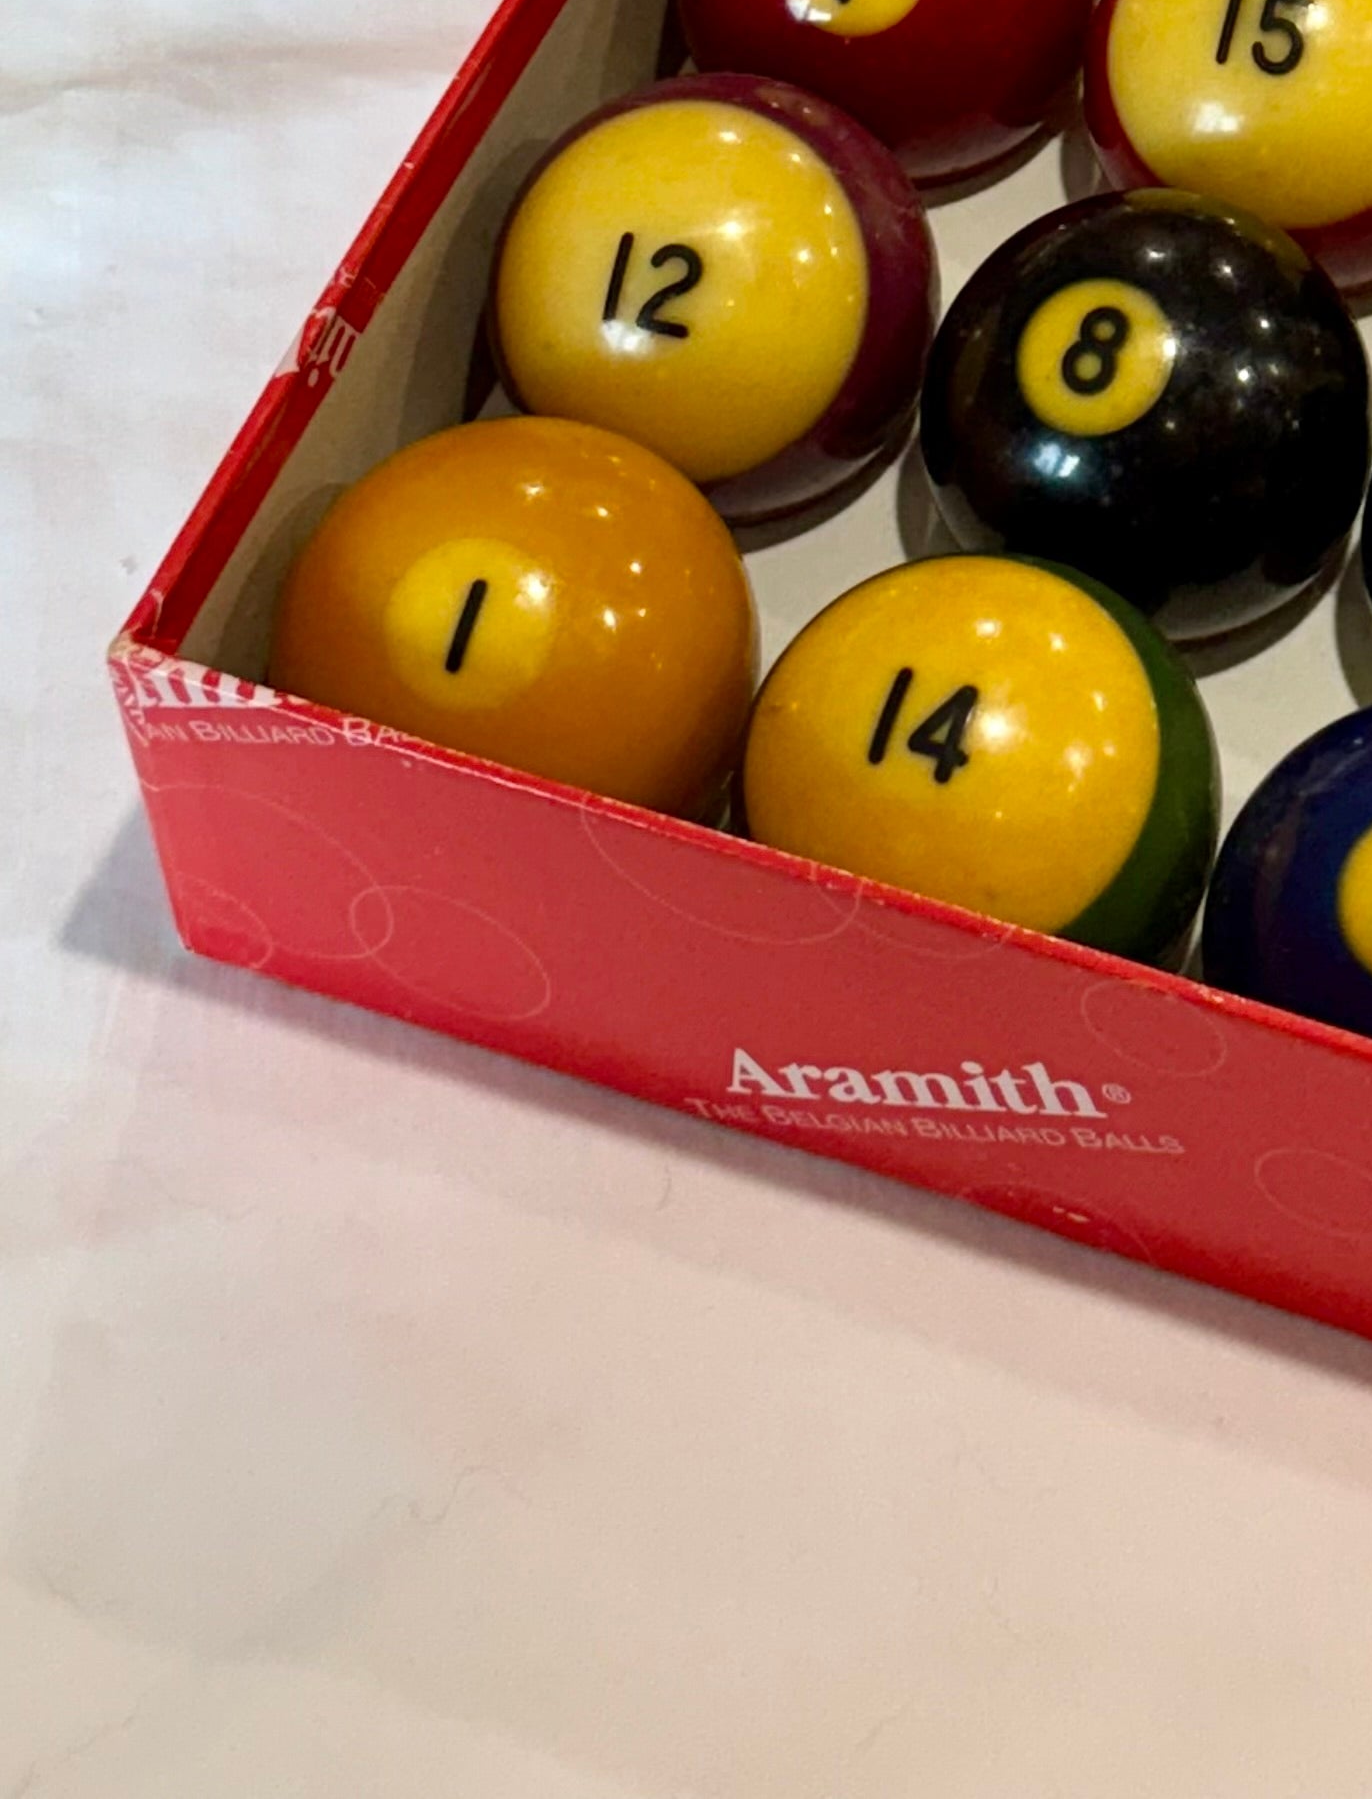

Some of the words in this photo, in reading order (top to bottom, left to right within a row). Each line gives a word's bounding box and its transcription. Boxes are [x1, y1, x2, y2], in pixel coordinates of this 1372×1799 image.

[601, 231, 704, 340] 12
[1061, 306, 1131, 397] 8
[444, 578, 488, 675] 1
[188, 720, 335, 746] BILLIARD
[867, 667, 979, 785] 14
[684, 1097, 754, 1122] THE
[762, 1104, 907, 1137] BELGIAN
[911, 1117, 1066, 1146] BILLIARD
[1070, 1127, 1185, 1154] BALLS
